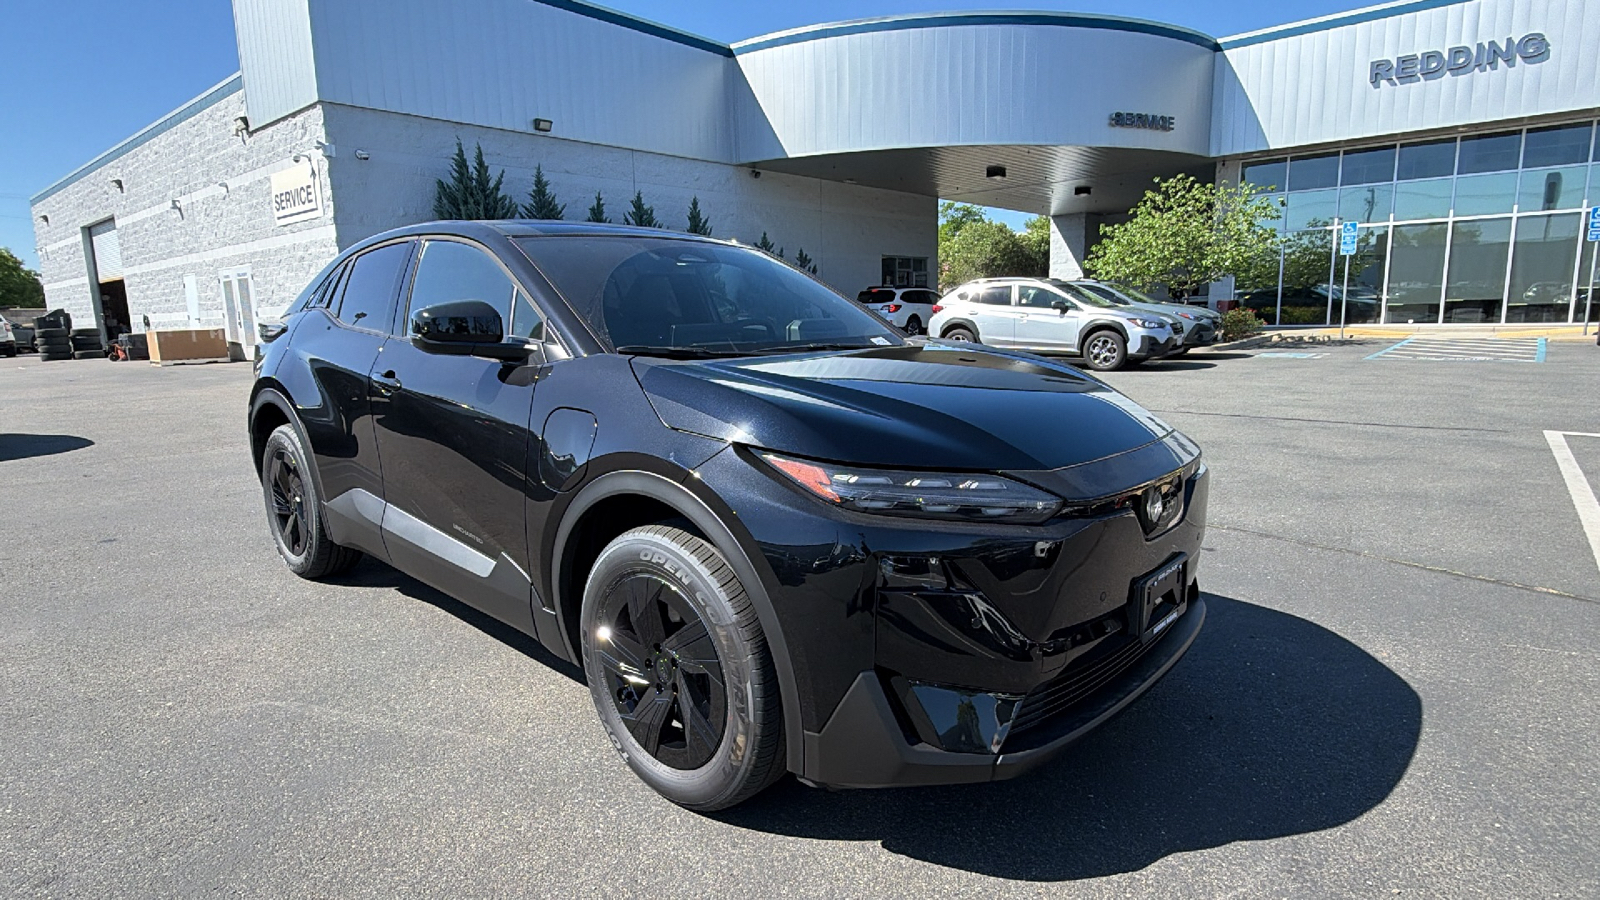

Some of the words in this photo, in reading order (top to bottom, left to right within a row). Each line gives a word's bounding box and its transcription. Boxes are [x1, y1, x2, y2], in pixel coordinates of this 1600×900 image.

[1369, 33, 1550, 87] REDDING
[1110, 112, 1175, 132] SERVICE
[274, 185, 313, 212] SERVICE
[640, 548, 693, 585] OPEN
